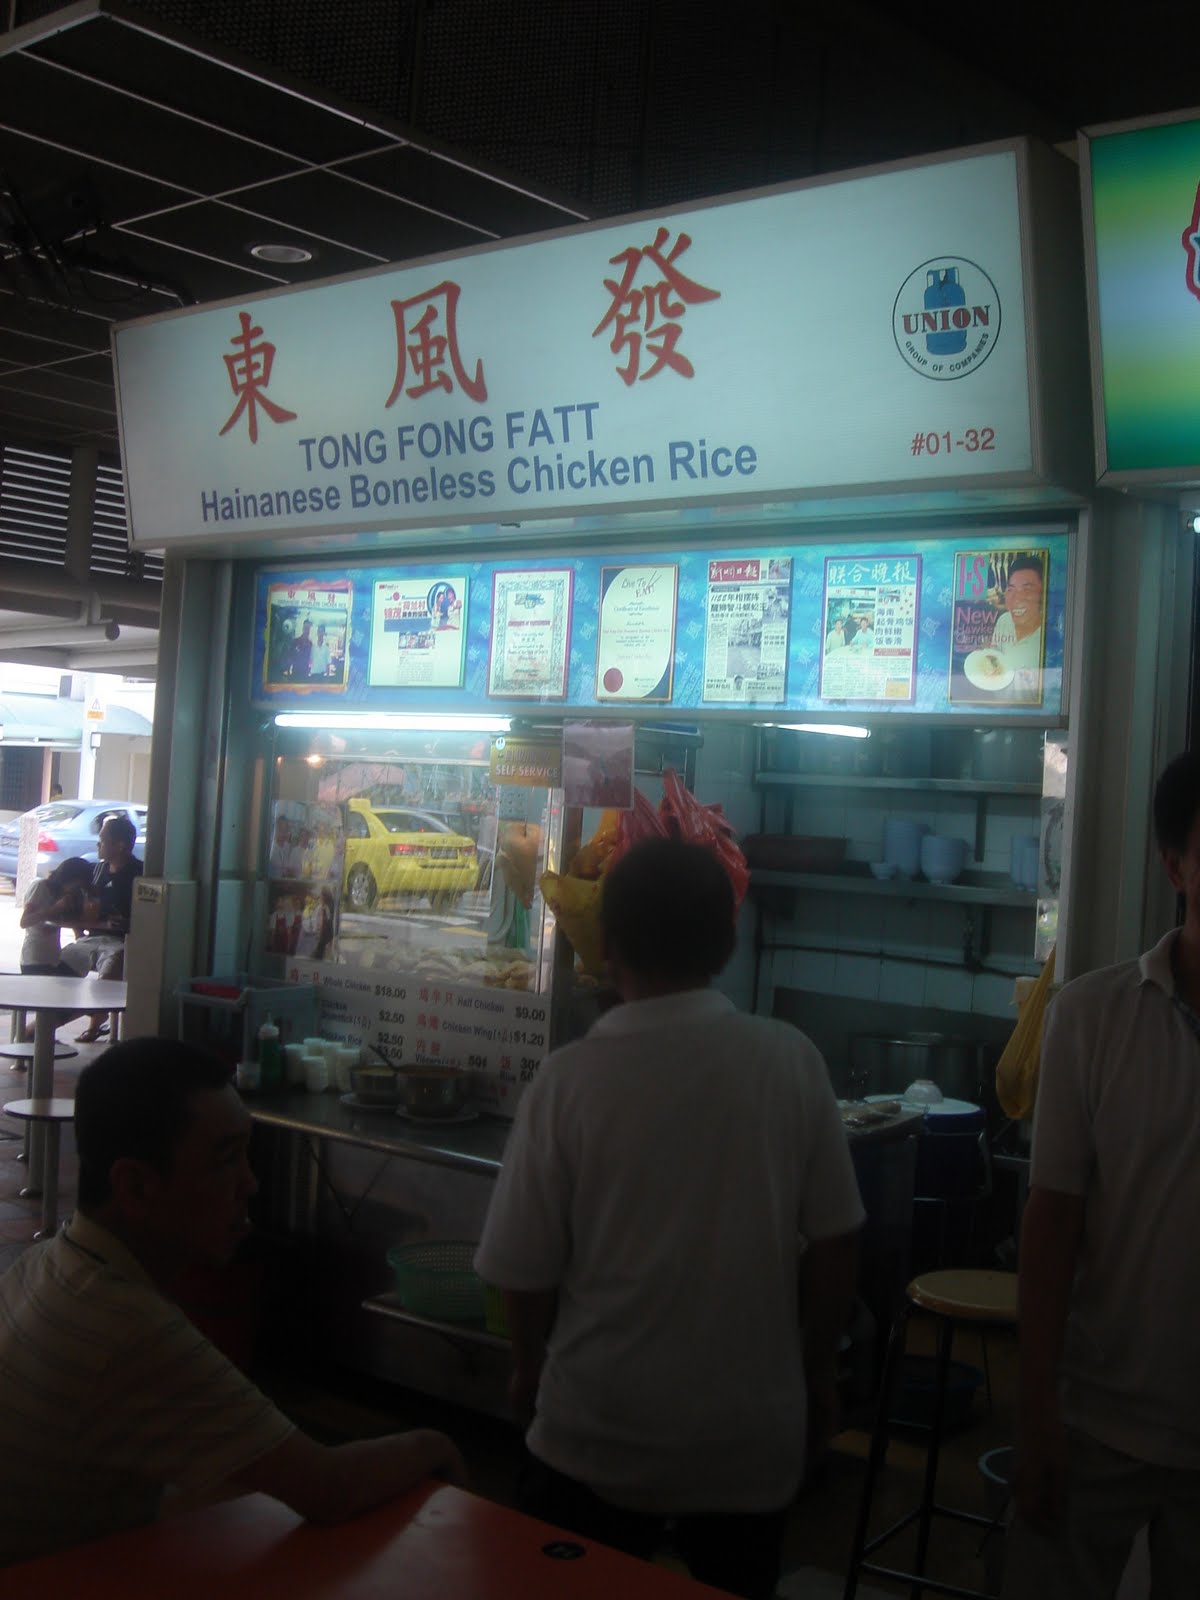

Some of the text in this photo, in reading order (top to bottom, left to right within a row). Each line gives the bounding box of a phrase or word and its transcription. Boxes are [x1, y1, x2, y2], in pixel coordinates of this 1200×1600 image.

[902, 305, 990, 335] UNION
[219, 227, 721, 445] 東風發
[905, 331, 989, 373] GROUP OF COMPANIES
[298, 402, 600, 474] TONG FONG FATT
[911, 427, 995, 456] #01-32
[201, 438, 758, 523] Hainanese Boneless Chicken Rice
[956, 606, 999, 625] New
[956, 624, 997, 634] Hawke
[496, 764, 558, 778] SELF SERVICE
[375, 985, 406, 999] $18.00
[379, 1009, 404, 1025] $2.50
[457, 996, 545, 1021] Half Chicken $9.00
[513, 1030, 544, 1046] $1.20
